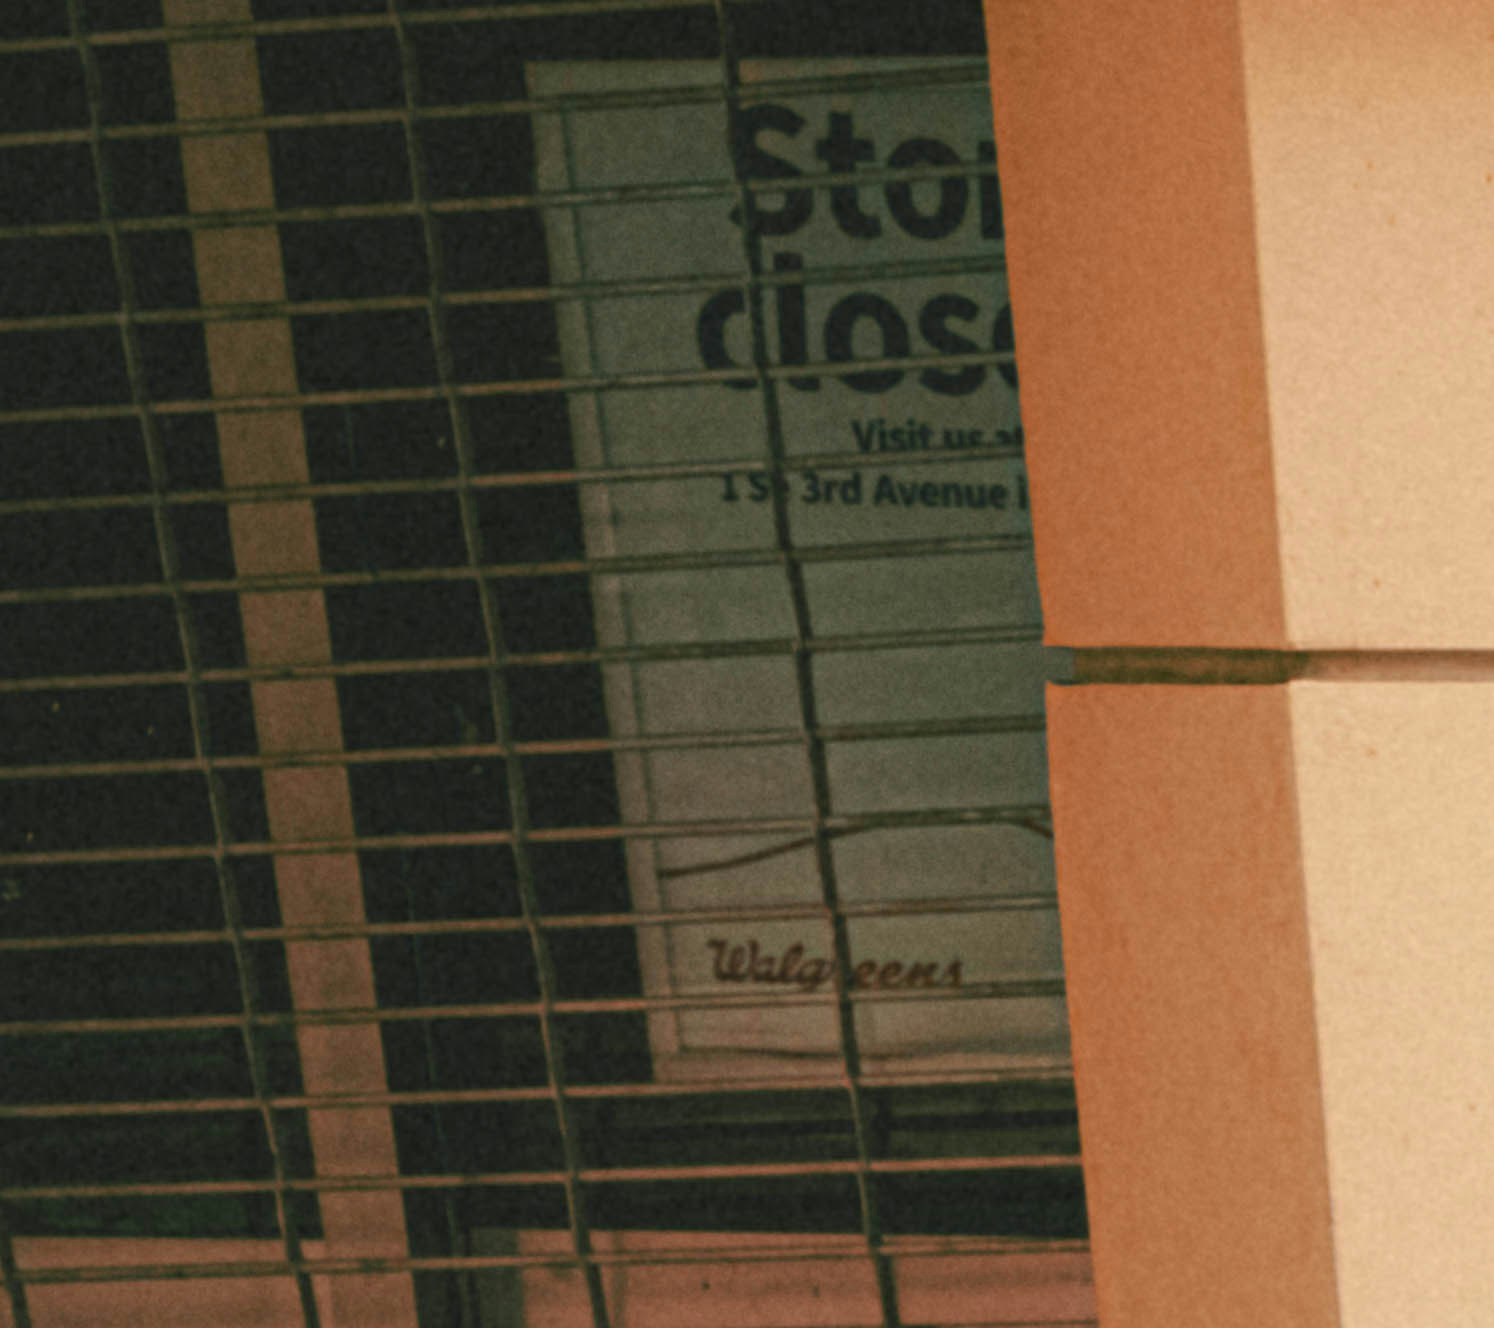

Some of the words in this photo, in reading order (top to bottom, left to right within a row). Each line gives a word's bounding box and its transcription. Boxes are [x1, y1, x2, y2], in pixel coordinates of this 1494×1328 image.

[852, 418, 932, 454] Visit
[802, 471, 862, 503] 3rd
[874, 473, 1010, 509] Avenue
[707, 939, 963, 993] Walgeens
